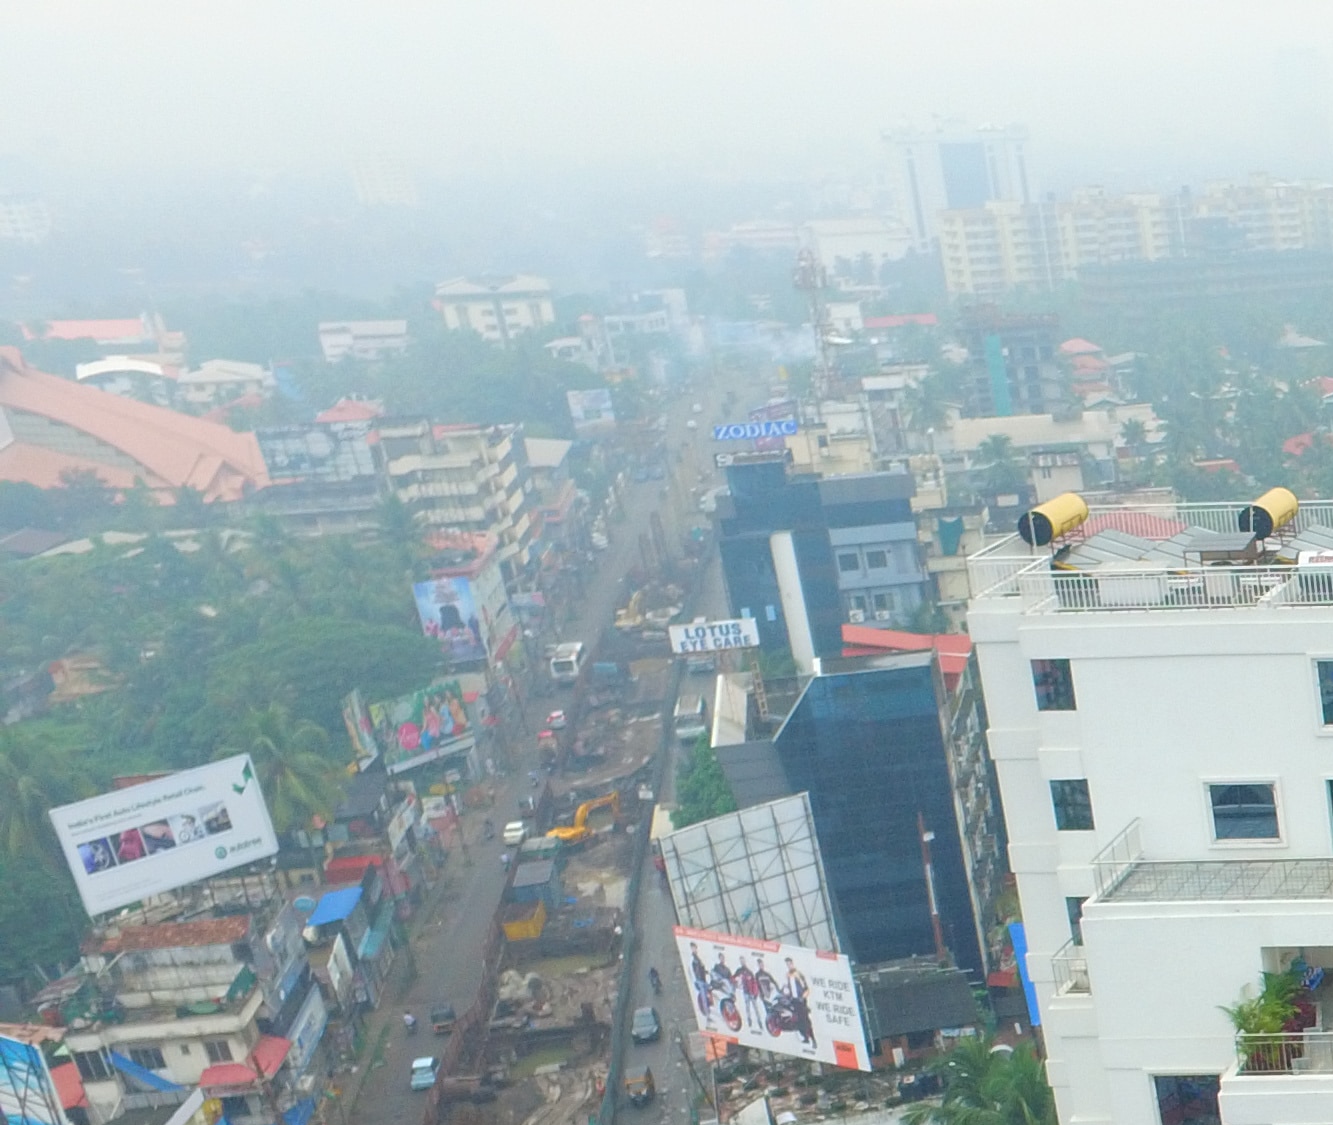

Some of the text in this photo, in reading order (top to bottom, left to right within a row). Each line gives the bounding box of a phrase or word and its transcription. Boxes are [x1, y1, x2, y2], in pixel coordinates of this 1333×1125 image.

[716, 421, 796, 440] ZODIAC
[684, 622, 741, 640] LOTUS
[680, 635, 751, 652] EYE CARE
[812, 976, 848, 992] WE RIDE
[823, 991, 842, 1001] KTM
[817, 1002, 855, 1017] WE RIDE
[825, 1014, 850, 1026] SAFE
